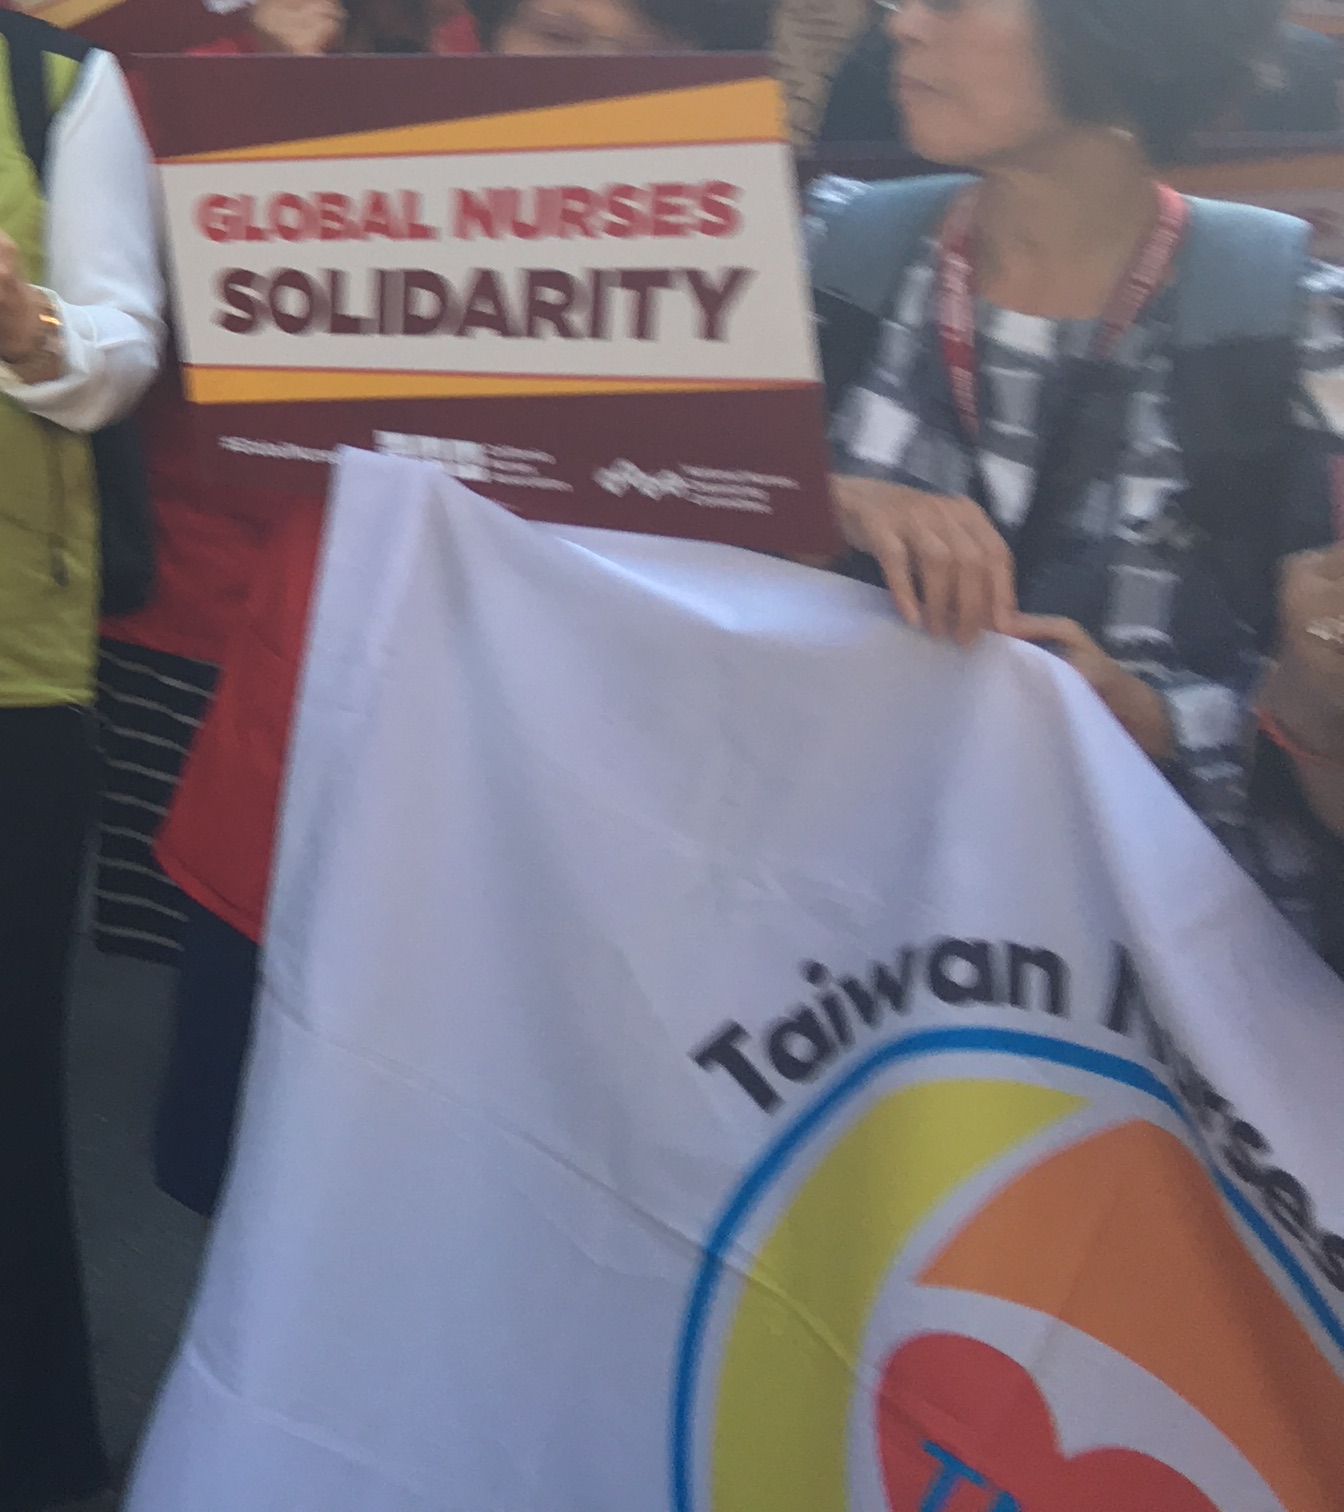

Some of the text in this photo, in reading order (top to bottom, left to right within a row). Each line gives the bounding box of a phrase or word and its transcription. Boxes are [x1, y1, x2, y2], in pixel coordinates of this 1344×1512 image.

[194, 179, 746, 243] GLOBAL NURSES
[212, 267, 760, 344] SOLIDARITY
[689, 934, 1072, 1116] Taiwan
